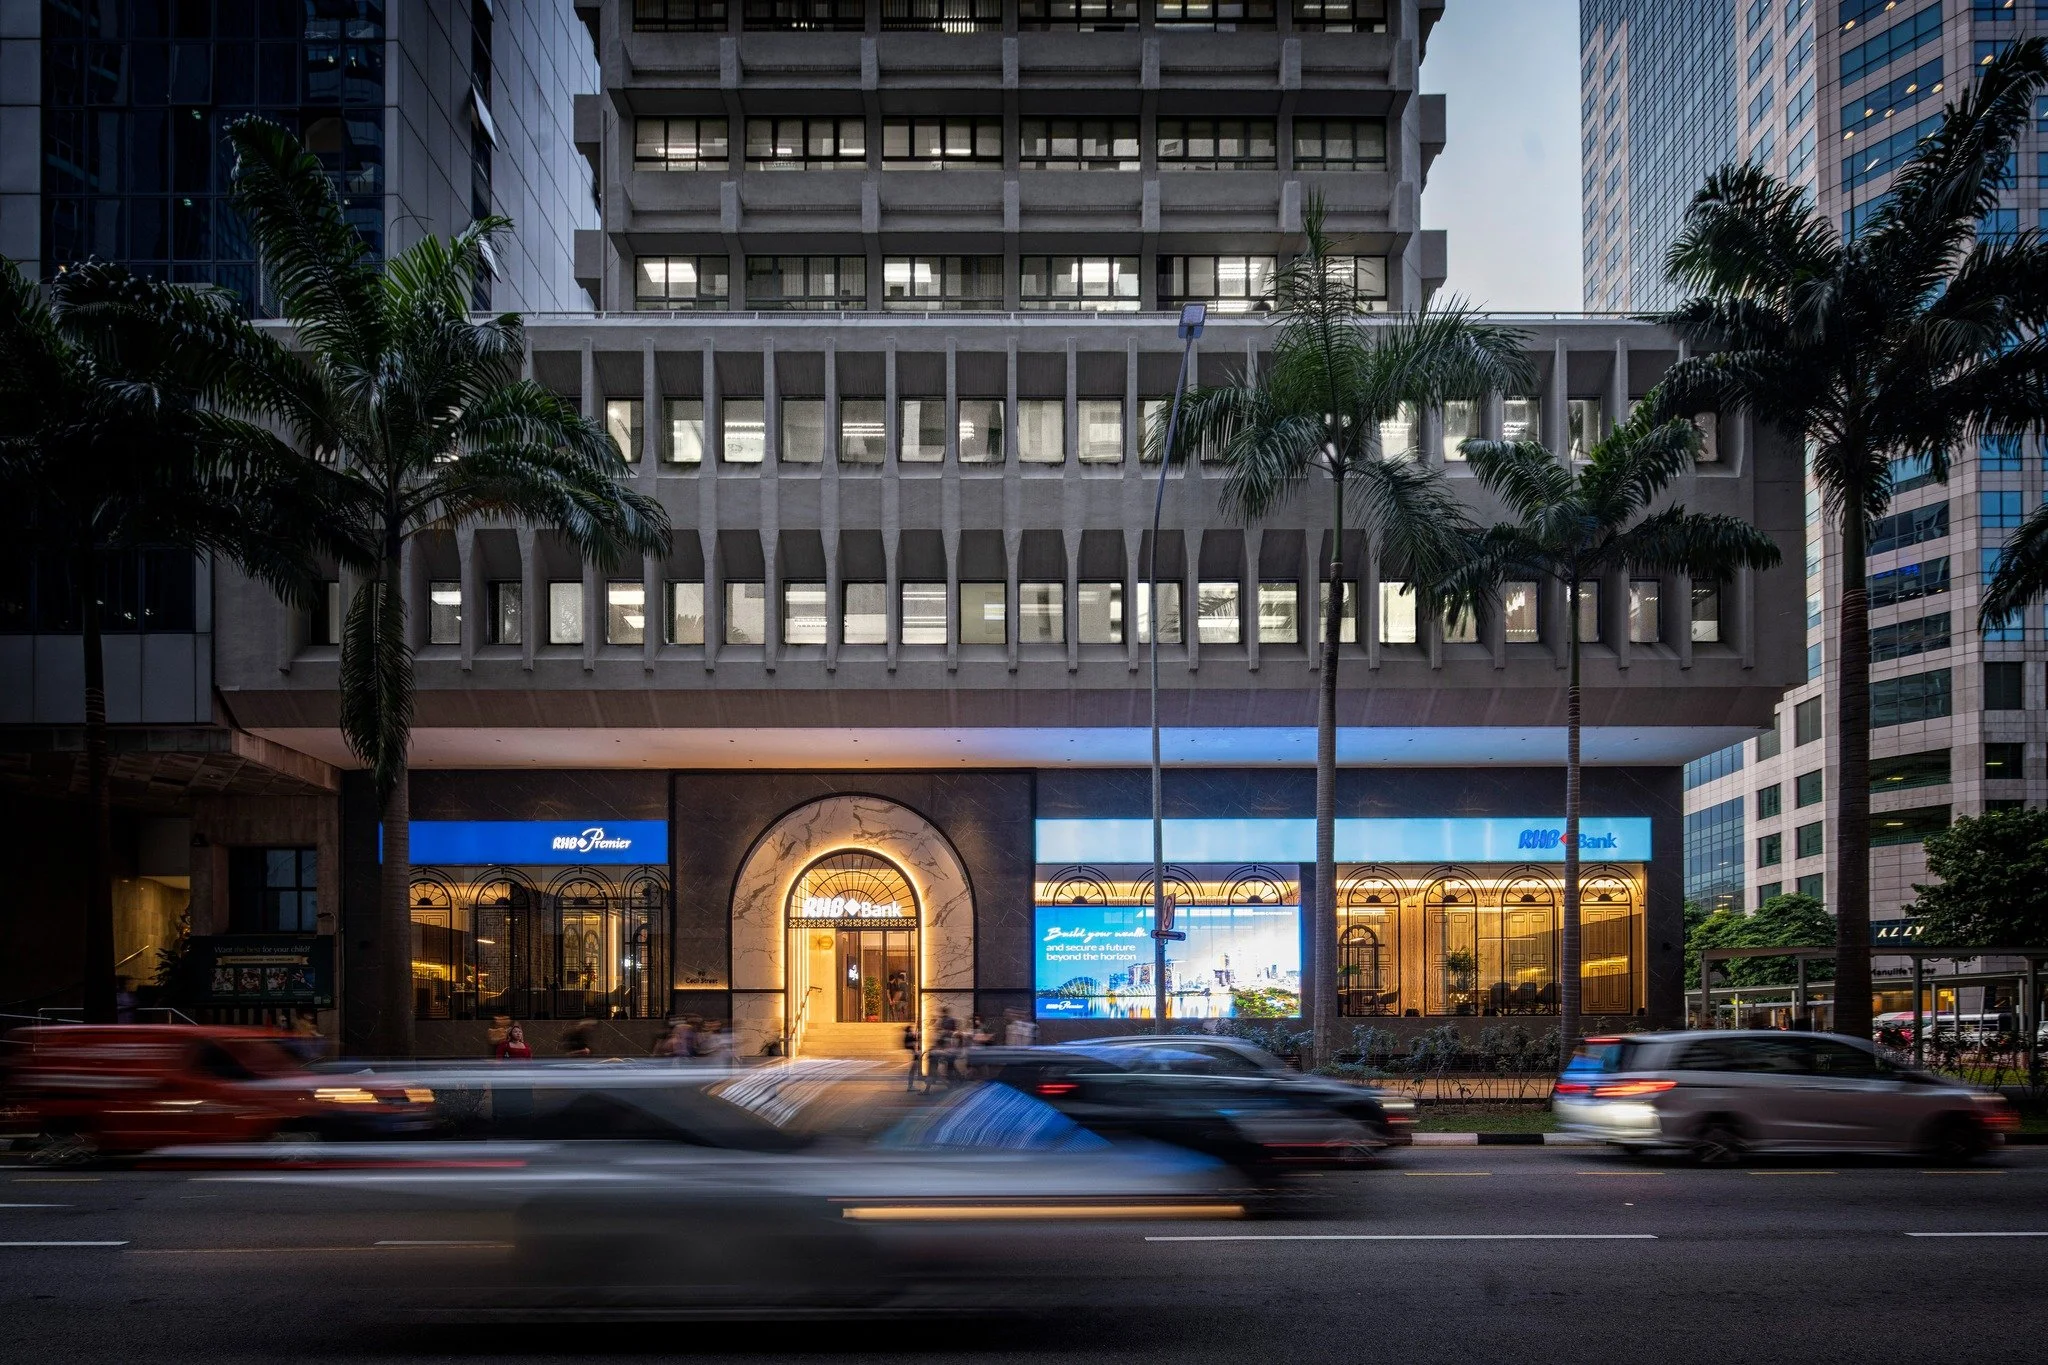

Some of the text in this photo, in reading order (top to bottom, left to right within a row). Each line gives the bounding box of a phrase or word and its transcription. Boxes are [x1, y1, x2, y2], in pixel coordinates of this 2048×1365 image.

[553, 828, 631, 852] RHB Premier
[1518, 829, 1617, 849] RHB Bank
[802, 897, 902, 917] RHB Bank
[1043, 927, 1148, 943] Build your wealth
[1046, 953, 1081, 962] beyond
